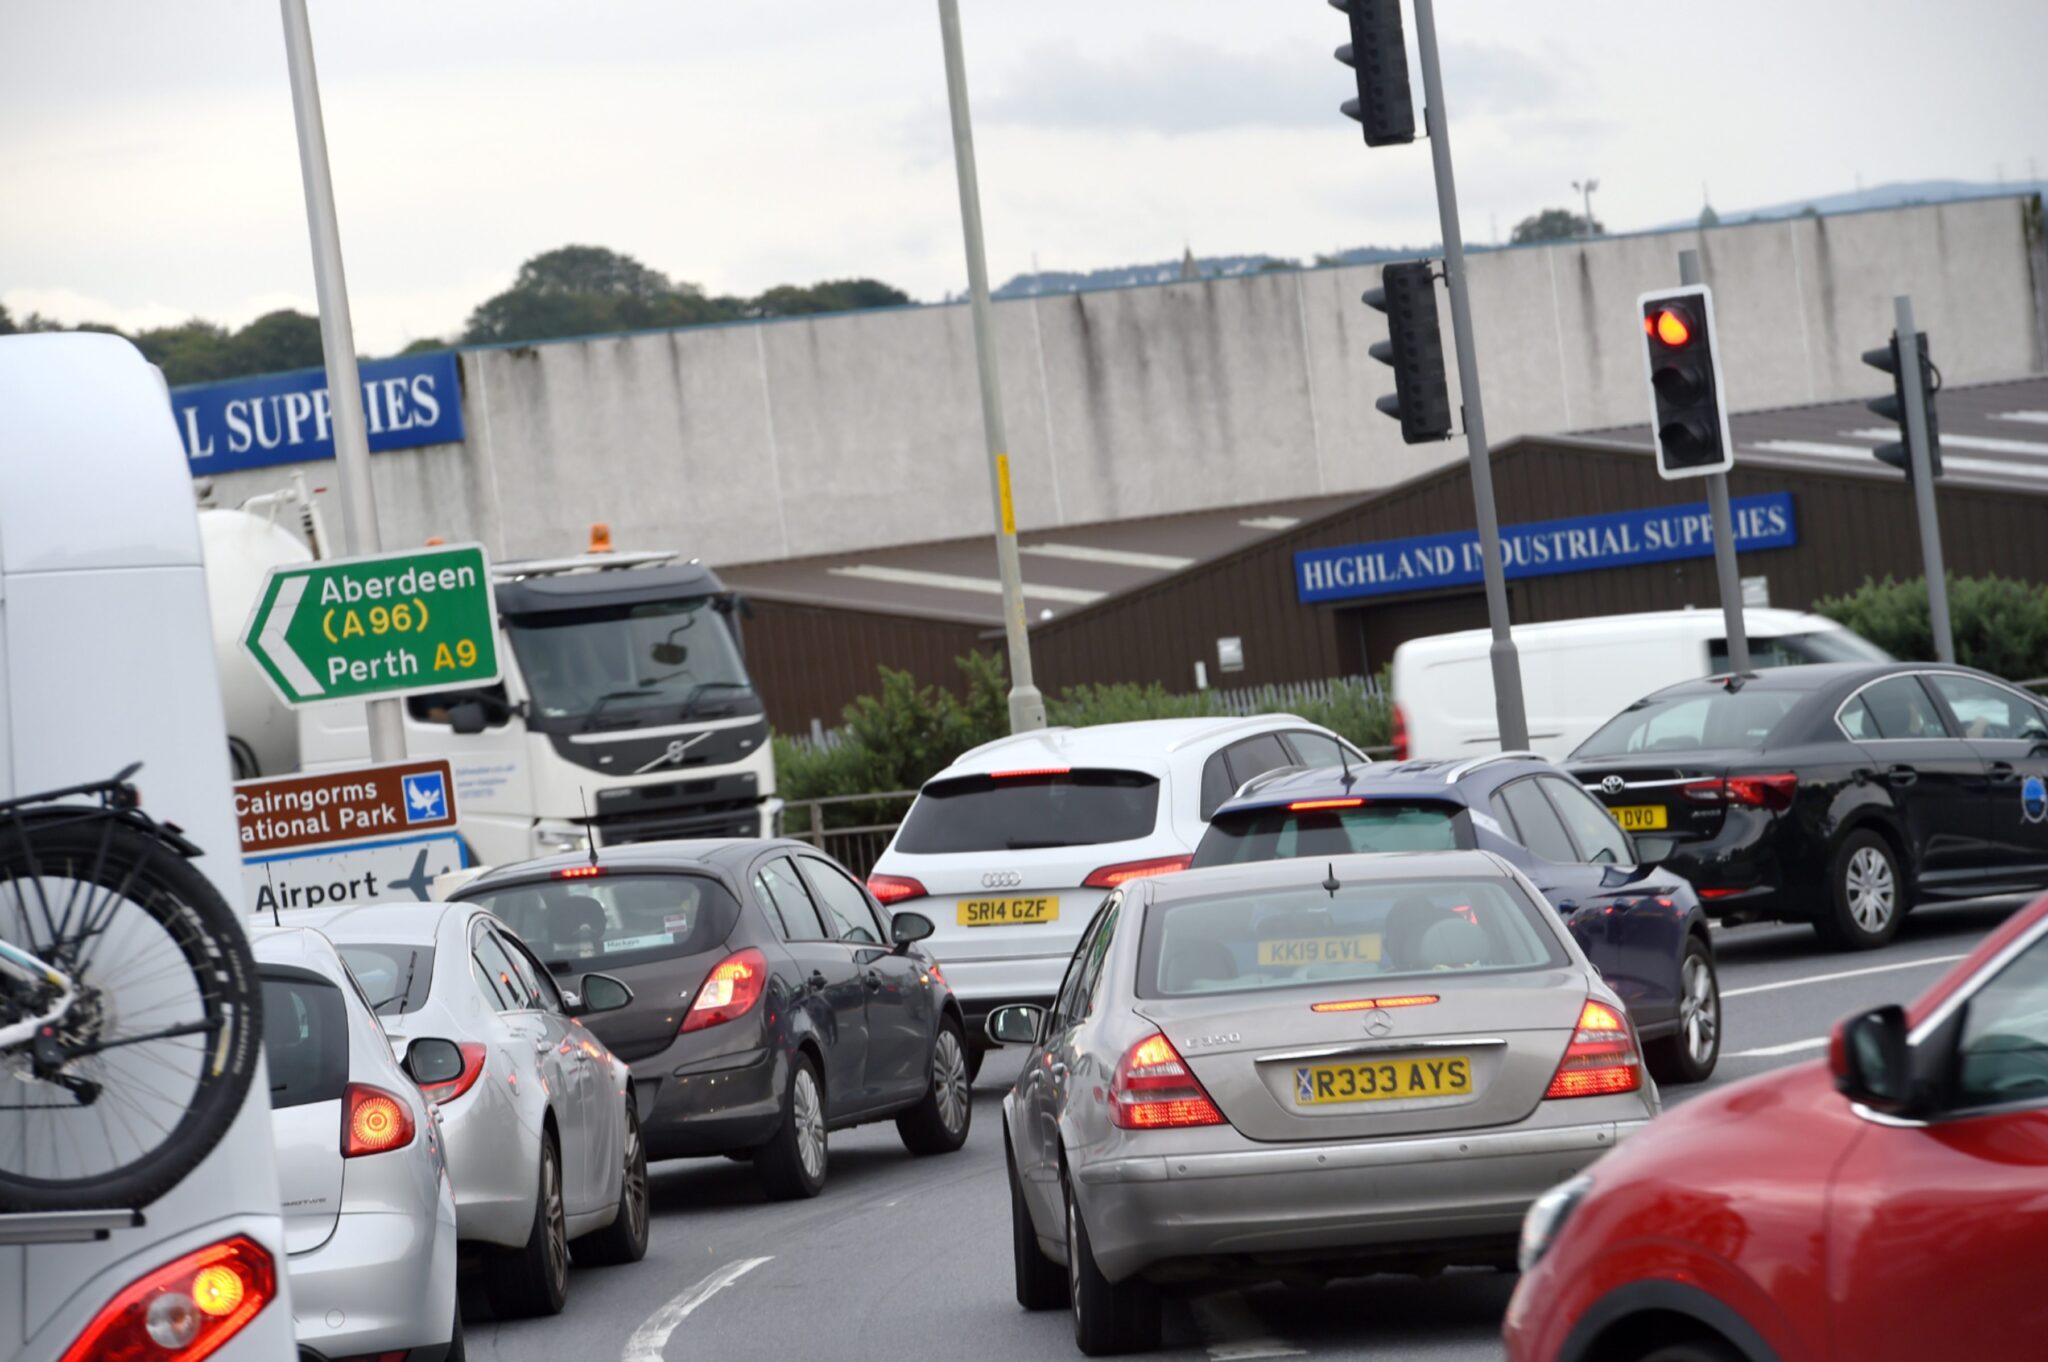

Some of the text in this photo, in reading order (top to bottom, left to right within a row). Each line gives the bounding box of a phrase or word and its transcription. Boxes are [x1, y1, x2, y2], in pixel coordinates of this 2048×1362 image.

[225, 374, 440, 452] SUPPIES
[1303, 545, 1455, 591] HIGHLAND
[1643, 505, 1787, 550] SUPPIES
[321, 566, 475, 606] Aberdeen
[327, 639, 477, 686] Perth A9
[233, 782, 378, 816] Cairngorms
[241, 803, 396, 843] ational Park
[255, 871, 378, 913] Airport
[967, 899, 1047, 921] SR14 GZF
[1325, 940, 1368, 960] GVL
[1317, 1060, 1468, 1098] R333 AYS
